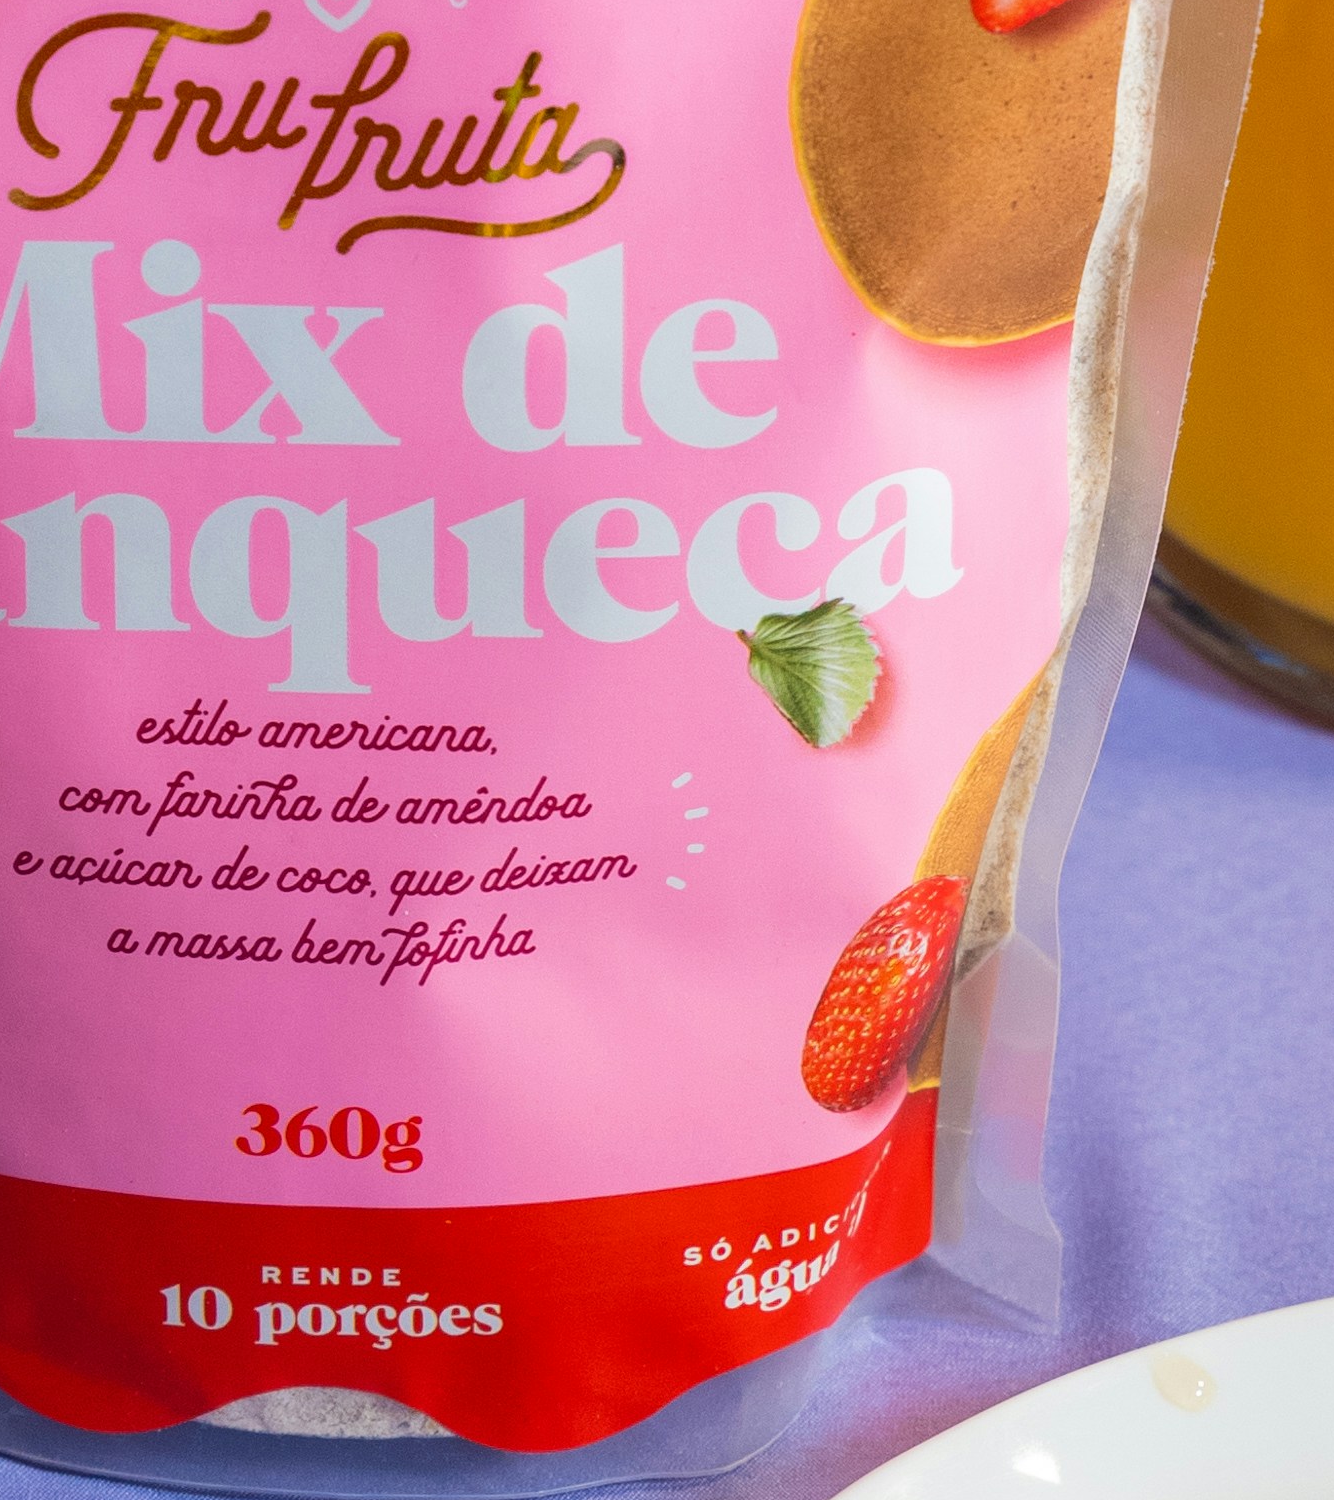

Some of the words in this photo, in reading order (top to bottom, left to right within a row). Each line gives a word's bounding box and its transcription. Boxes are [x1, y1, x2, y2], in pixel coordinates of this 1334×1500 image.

[462, 241, 779, 452] de
[136, 698, 252, 746] estilo
[258, 715, 498, 756] americana,
[58, 786, 151, 816] com
[146, 770, 323, 837] farinha
[331, 775, 390, 823] de
[395, 775, 592, 824] amêndoa
[13, 850, 44, 876] e
[49, 848, 203, 890] açúcar
[212, 844, 270, 891] de
[276, 866, 377, 898] coco,
[390, 869, 475, 917] que
[480, 846, 638, 893] deixam
[107, 928, 140, 954] a
[145, 931, 283, 962] massa
[291, 918, 386, 966] bem
[379, 913, 537, 987] fofinha
[234, 1102, 425, 1174] 360g
[261, 1265, 402, 1287] RENDE
[683, 1237, 733, 1266] SÓ
[724, 1240, 840, 1312] água
[159, 1283, 234, 1330] 10
[253, 1292, 505, 1350] porções
